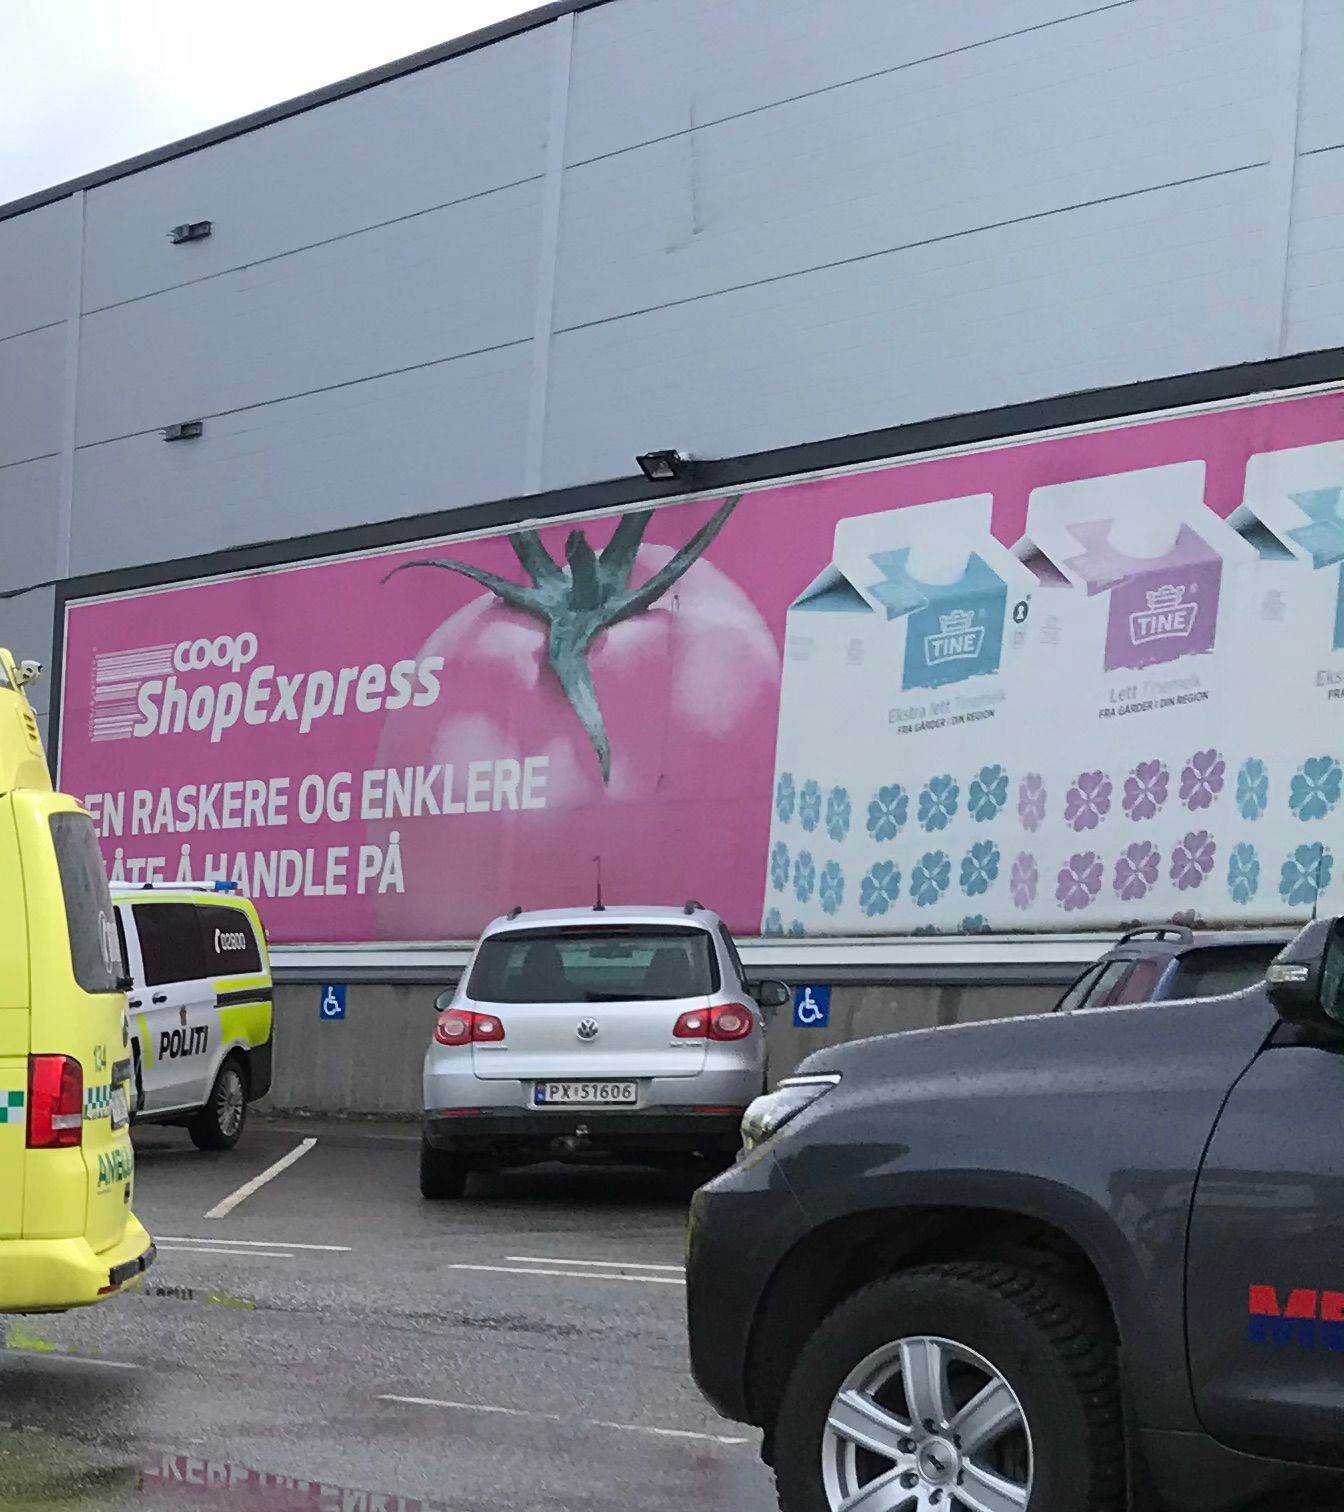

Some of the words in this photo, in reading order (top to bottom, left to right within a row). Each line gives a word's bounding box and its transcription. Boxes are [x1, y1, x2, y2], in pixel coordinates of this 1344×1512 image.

[1137, 613, 1187, 636] TINE
[173, 632, 258, 673] coop
[932, 634, 975, 658] TINE
[133, 656, 445, 743] ShopExpress
[131, 776, 290, 836] RASKERE
[298, 771, 352, 824] OG
[360, 755, 550, 820] ENKLERE
[103, 848, 166, 882] ÅTE
[204, 846, 350, 898] HANDLE
[357, 830, 405, 895] PÅ
[159, 1025, 209, 1060] POLITI
[549, 1082, 571, 1099] PX
[581, 1082, 632, 1099] 51606
